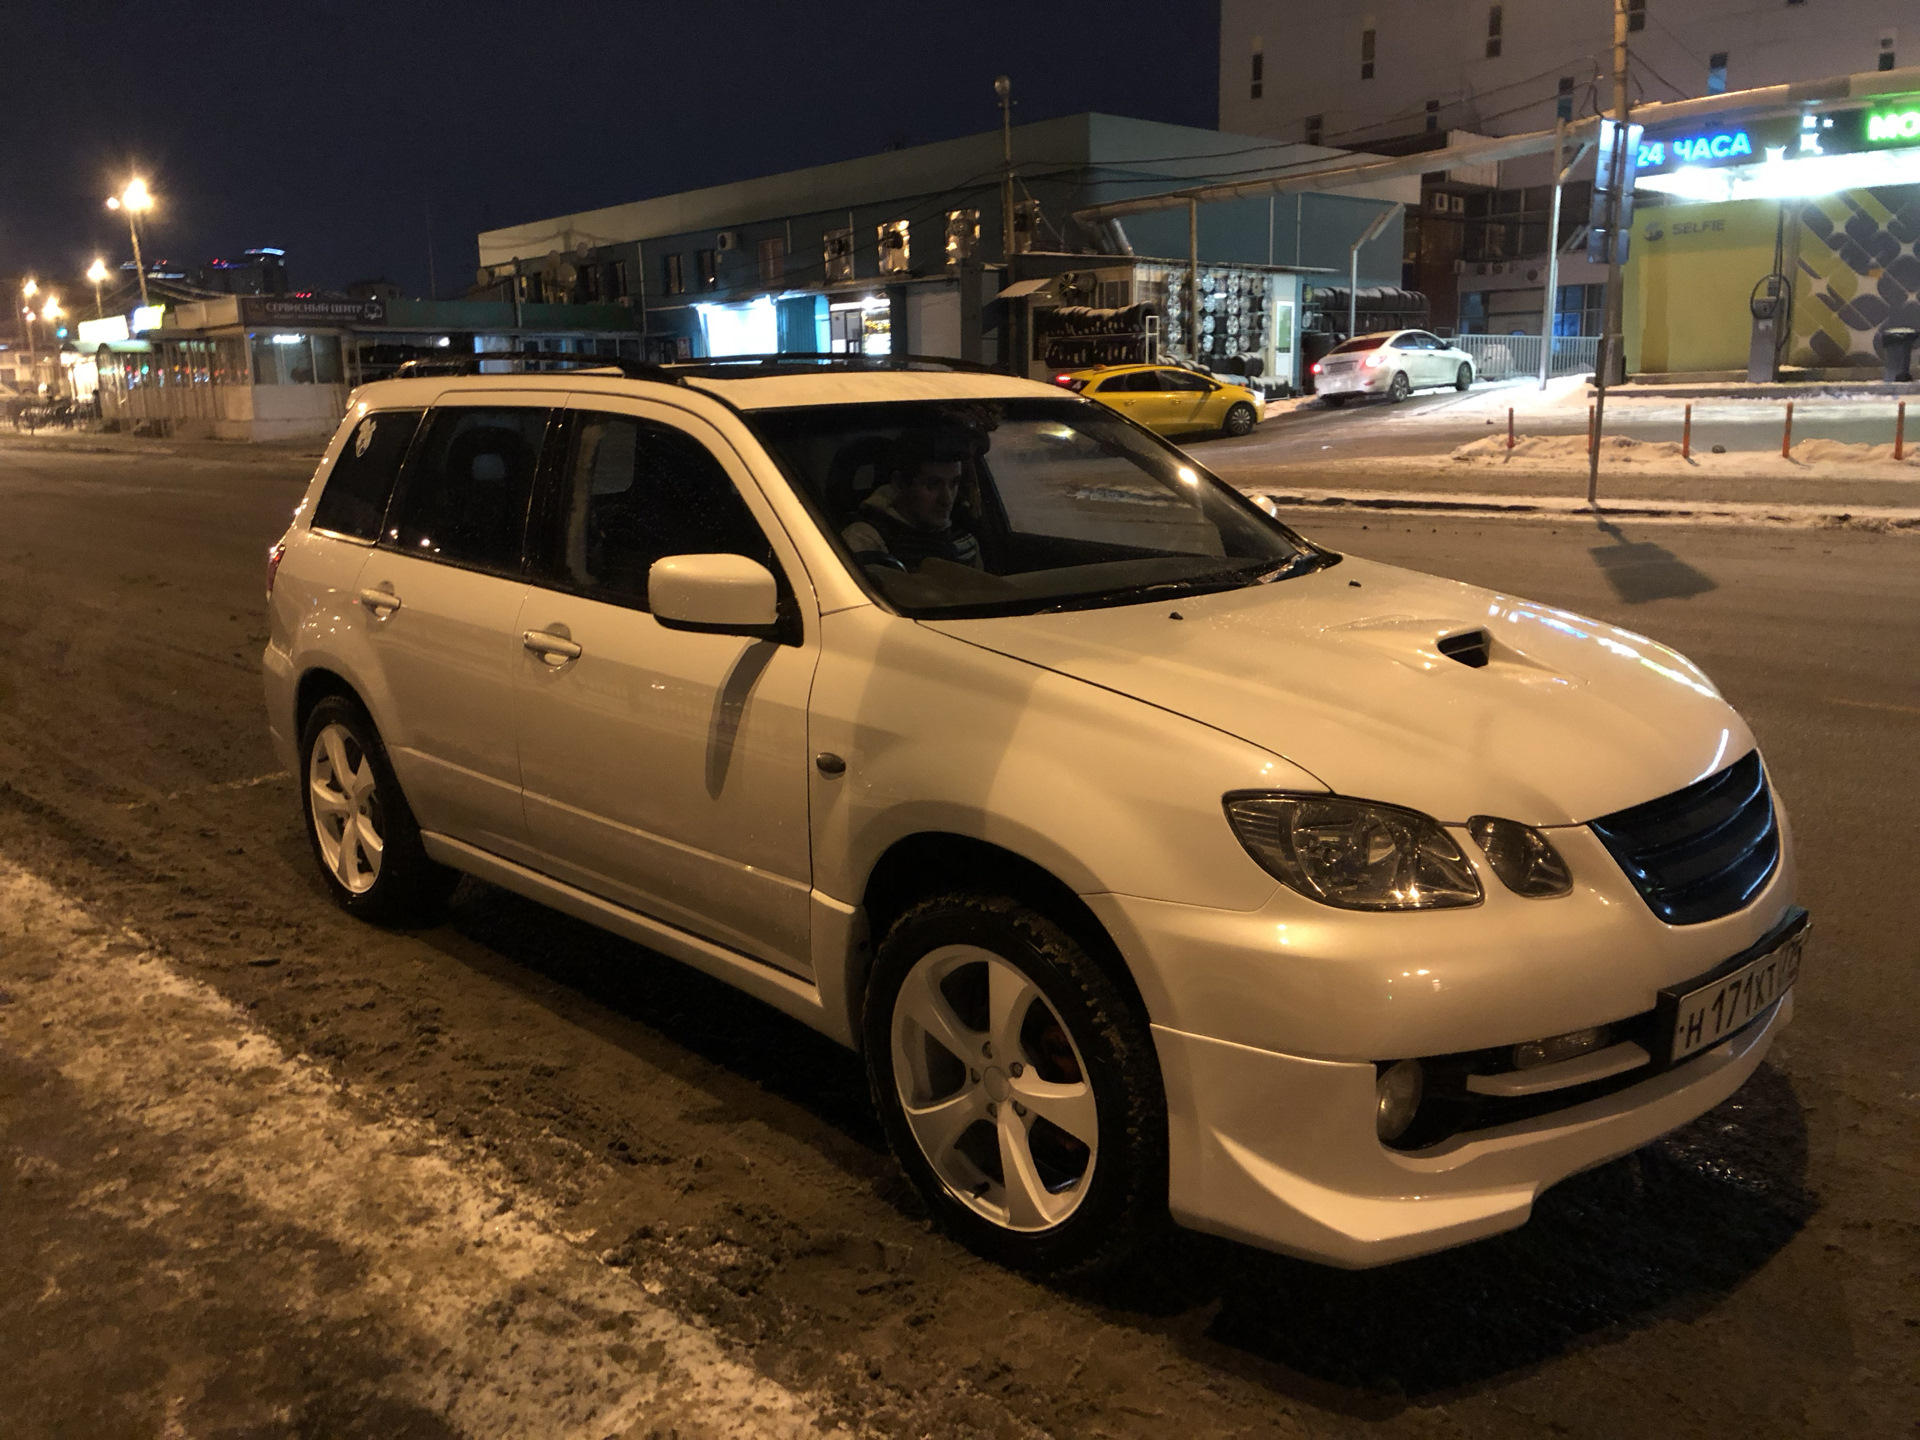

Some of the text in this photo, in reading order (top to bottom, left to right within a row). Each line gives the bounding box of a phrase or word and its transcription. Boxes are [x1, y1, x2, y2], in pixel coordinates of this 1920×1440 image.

[1637, 132, 1751, 167] 24 ЧАСА
[1672, 219, 1725, 235] SELFIE
